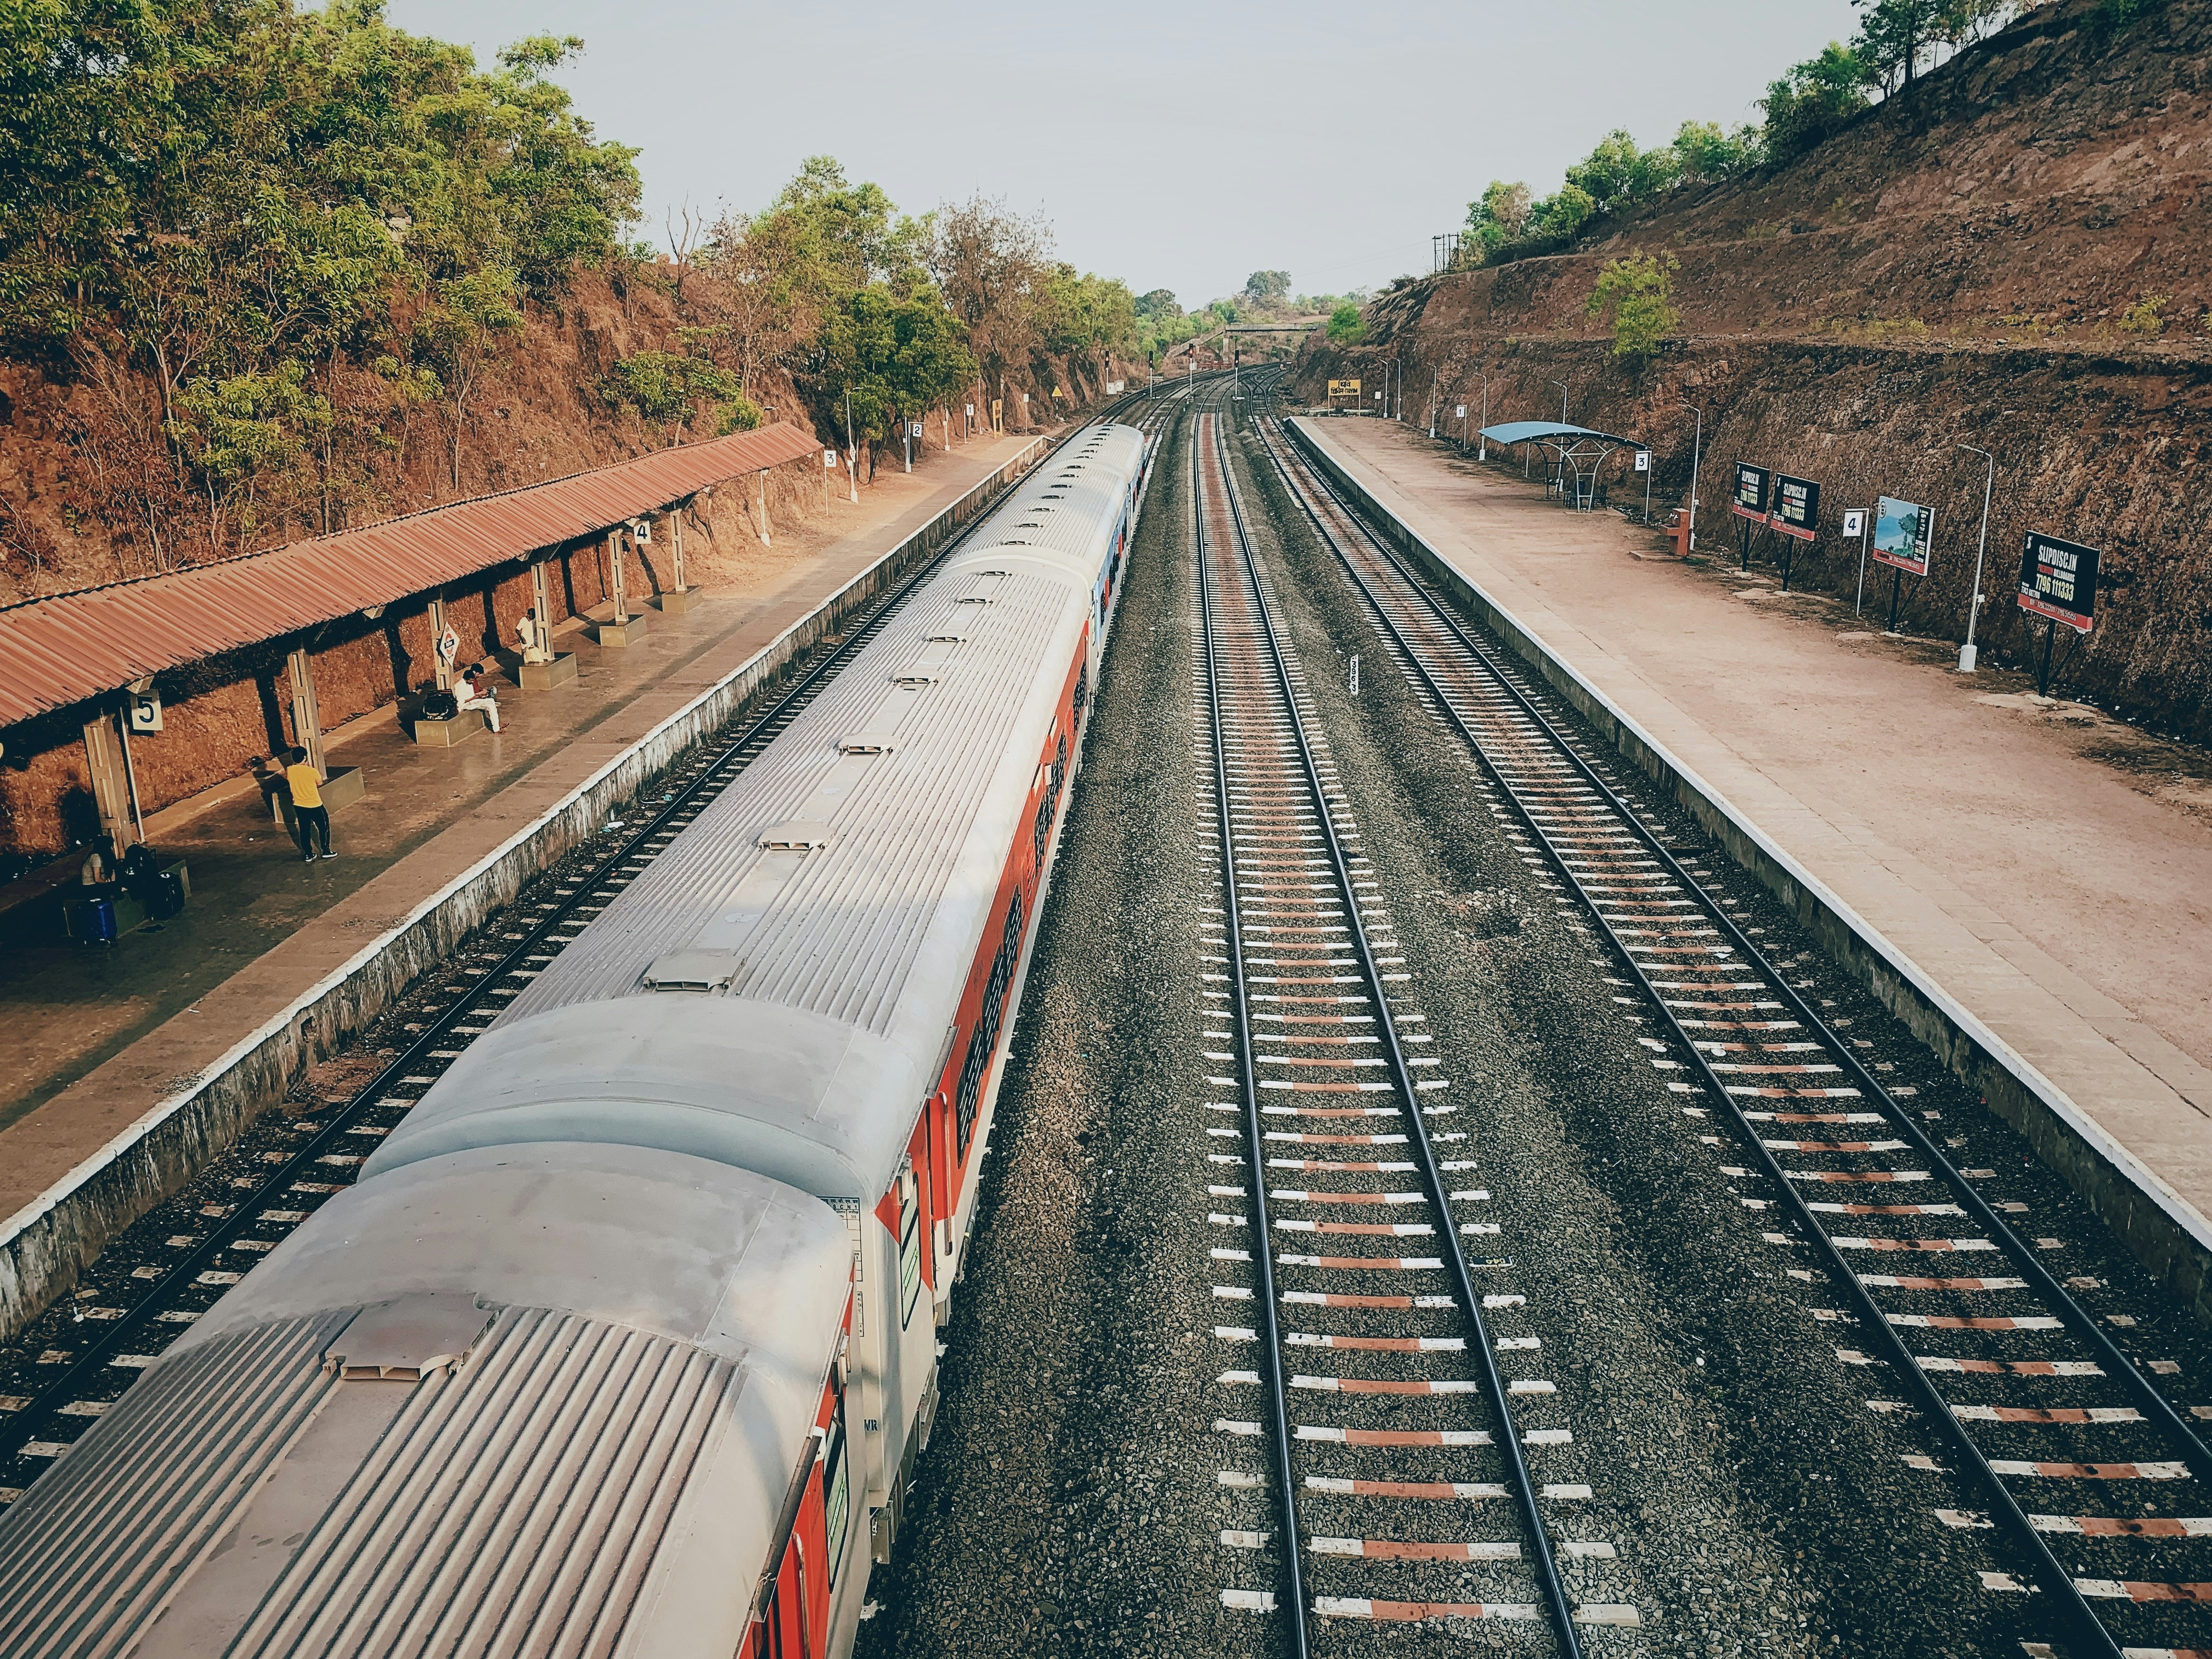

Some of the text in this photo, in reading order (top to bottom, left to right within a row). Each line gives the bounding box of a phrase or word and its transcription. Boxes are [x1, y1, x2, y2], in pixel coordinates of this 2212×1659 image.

[915, 426, 920, 435] 2
[827, 454, 834, 464] 3
[1639, 458, 1645, 466] 3
[1848, 517, 1856, 531] 4
[636, 524, 648, 540] 4
[2038, 544, 2078, 572] SLIPDISC.IN
[2035, 573, 2051, 593] 7796
[2052, 579, 2074, 601] 111333
[137, 696, 154, 723] 5
